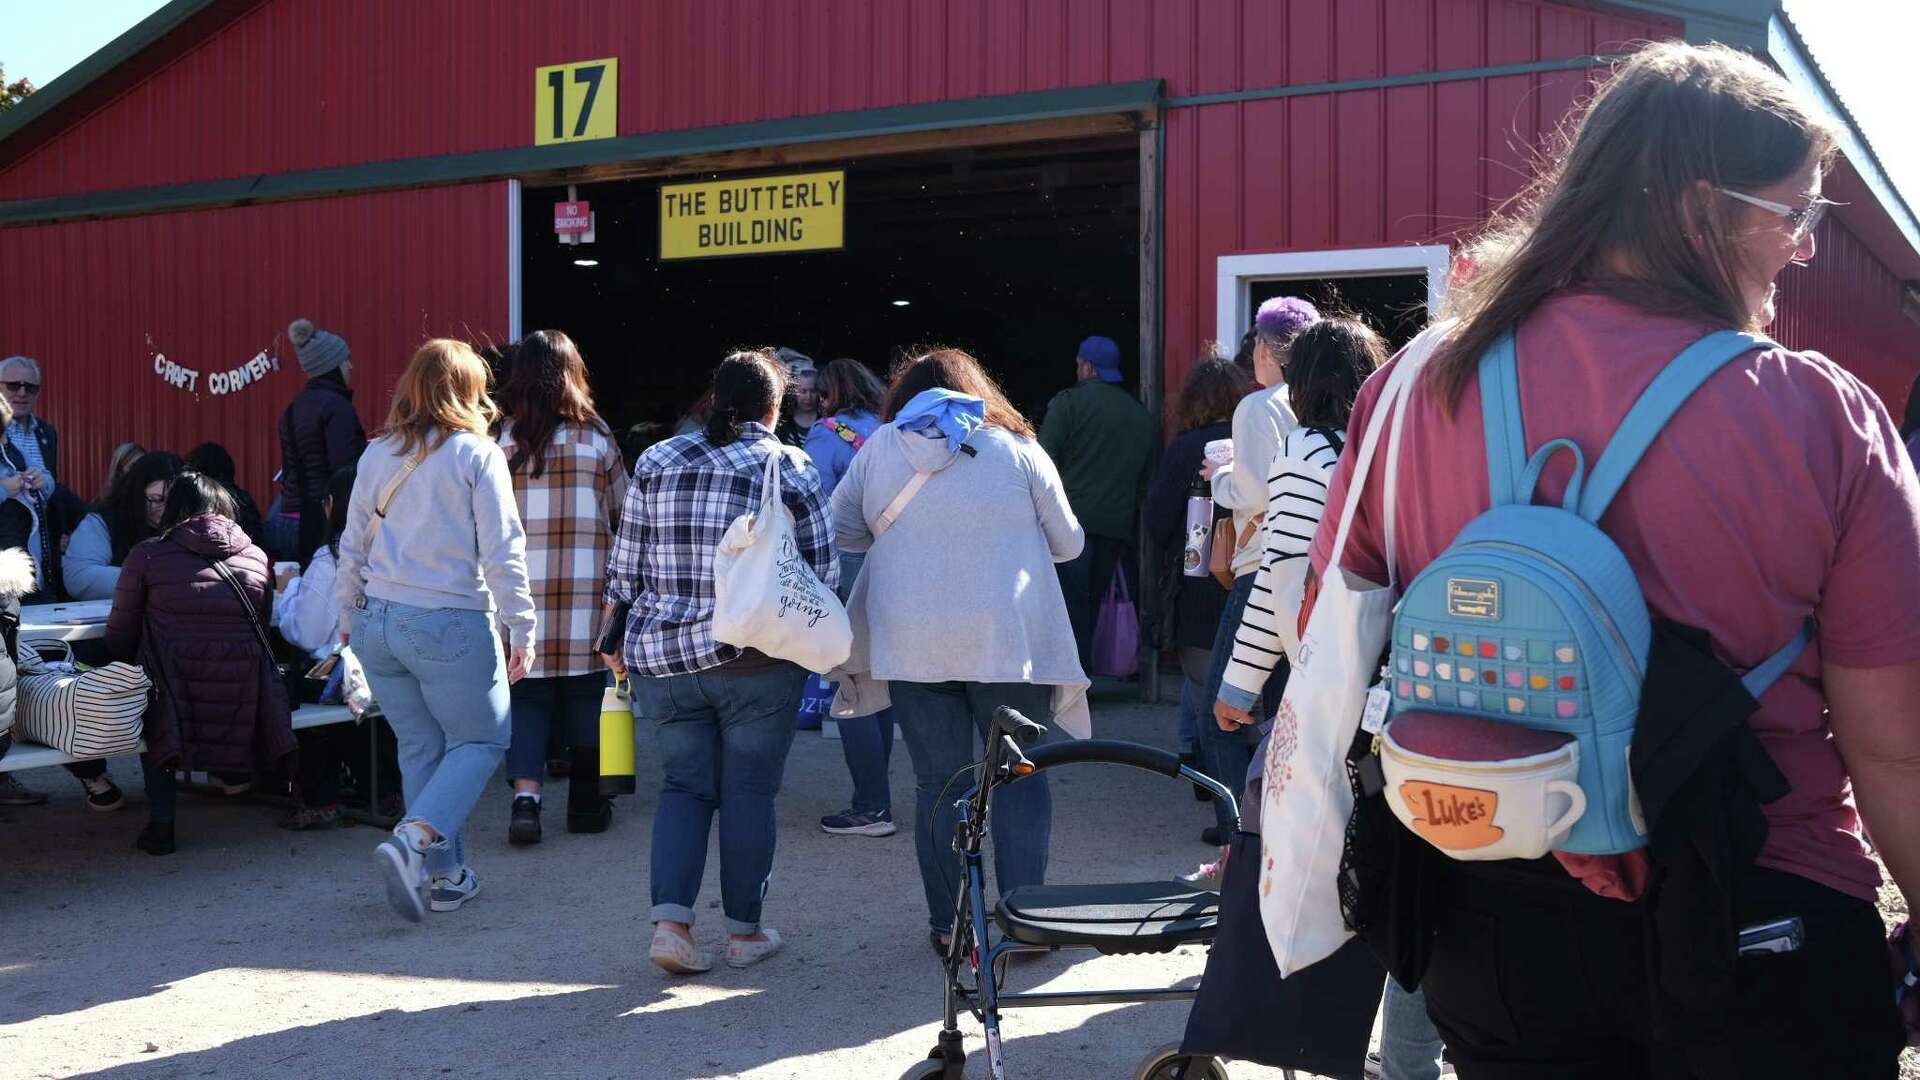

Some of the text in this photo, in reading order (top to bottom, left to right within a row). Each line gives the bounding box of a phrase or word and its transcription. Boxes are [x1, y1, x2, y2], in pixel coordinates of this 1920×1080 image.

[548, 65, 606, 139] 17
[566, 205, 578, 216] NO
[665, 180, 840, 218] THE BUTTERLY
[698, 217, 803, 248] BUILDING
[154, 351, 272, 395] CRAFT CORNER
[778, 595, 830, 628] going
